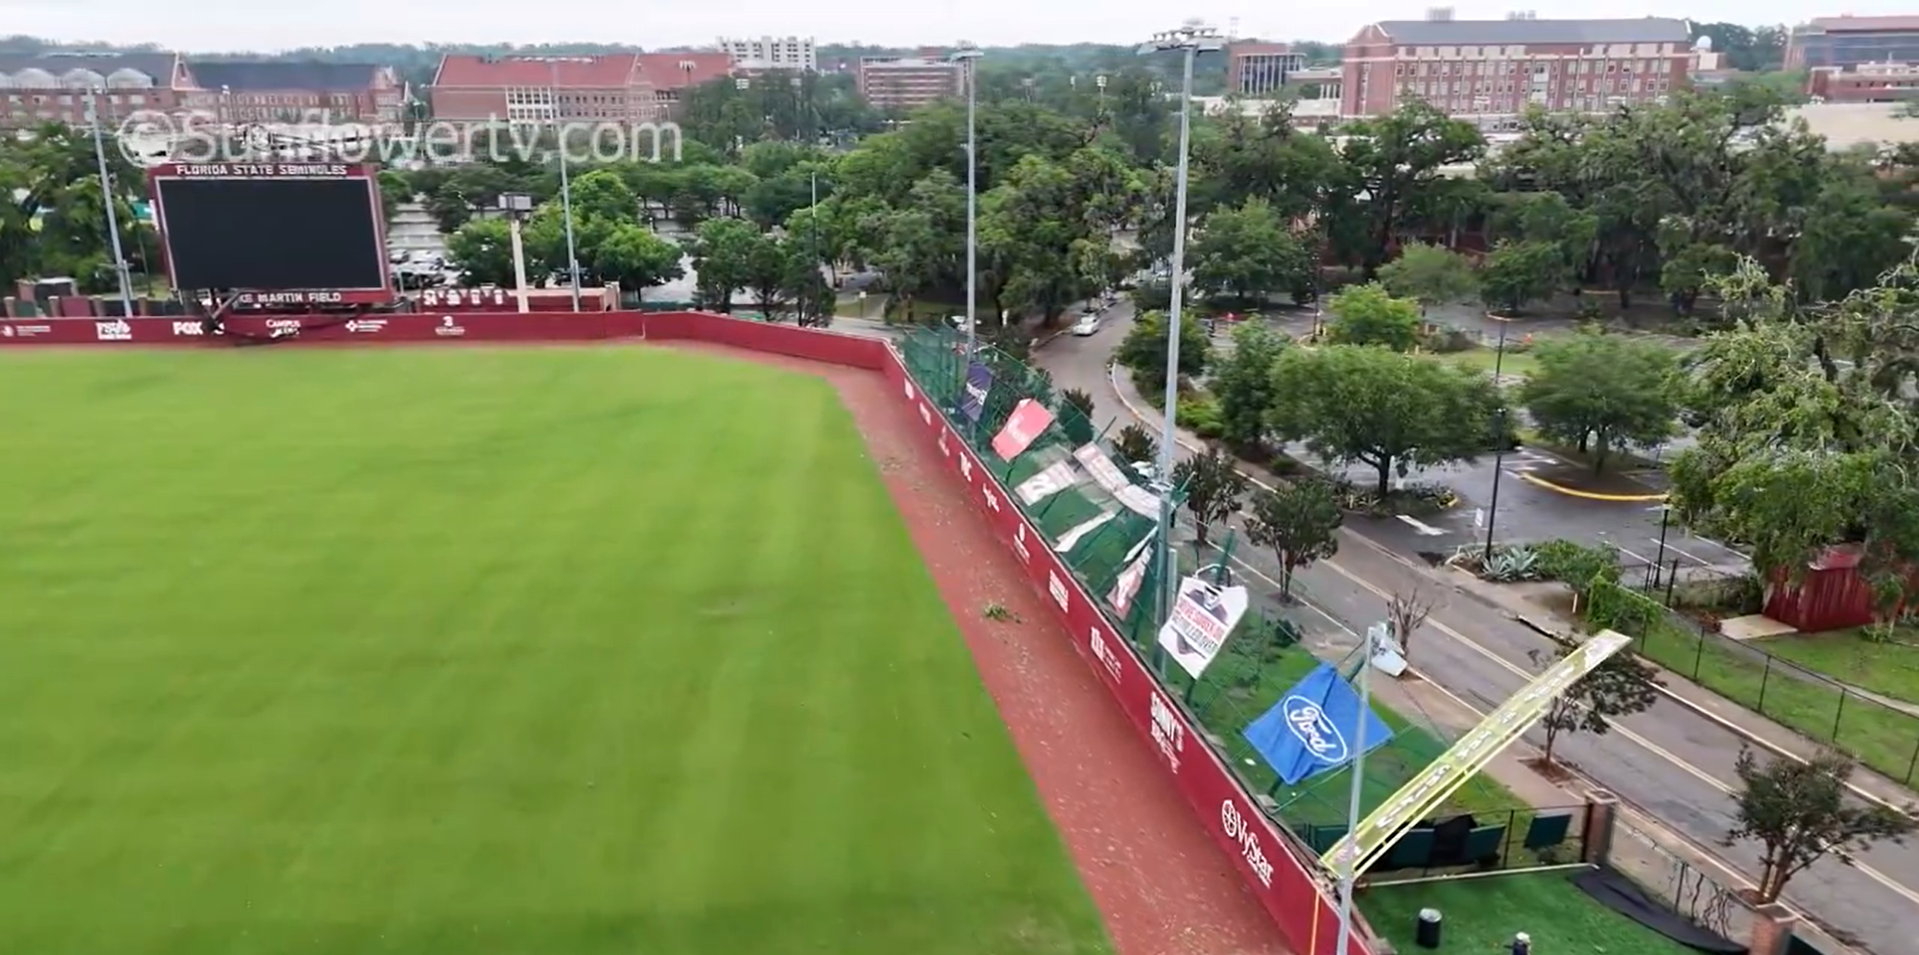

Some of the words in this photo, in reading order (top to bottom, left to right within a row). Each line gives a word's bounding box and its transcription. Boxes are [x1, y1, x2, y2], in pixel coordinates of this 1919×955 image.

[175, 164, 228, 175] FLORIDA
[234, 164, 273, 175] STATE
[279, 164, 347, 175] SEMINOLES
[257, 292, 303, 303] MARTIN
[308, 291, 341, 302] FIELD
[172, 321, 203, 335] FOX
[1290, 706, 1337, 753] Ford
[1236, 811, 1274, 884] VyStar
